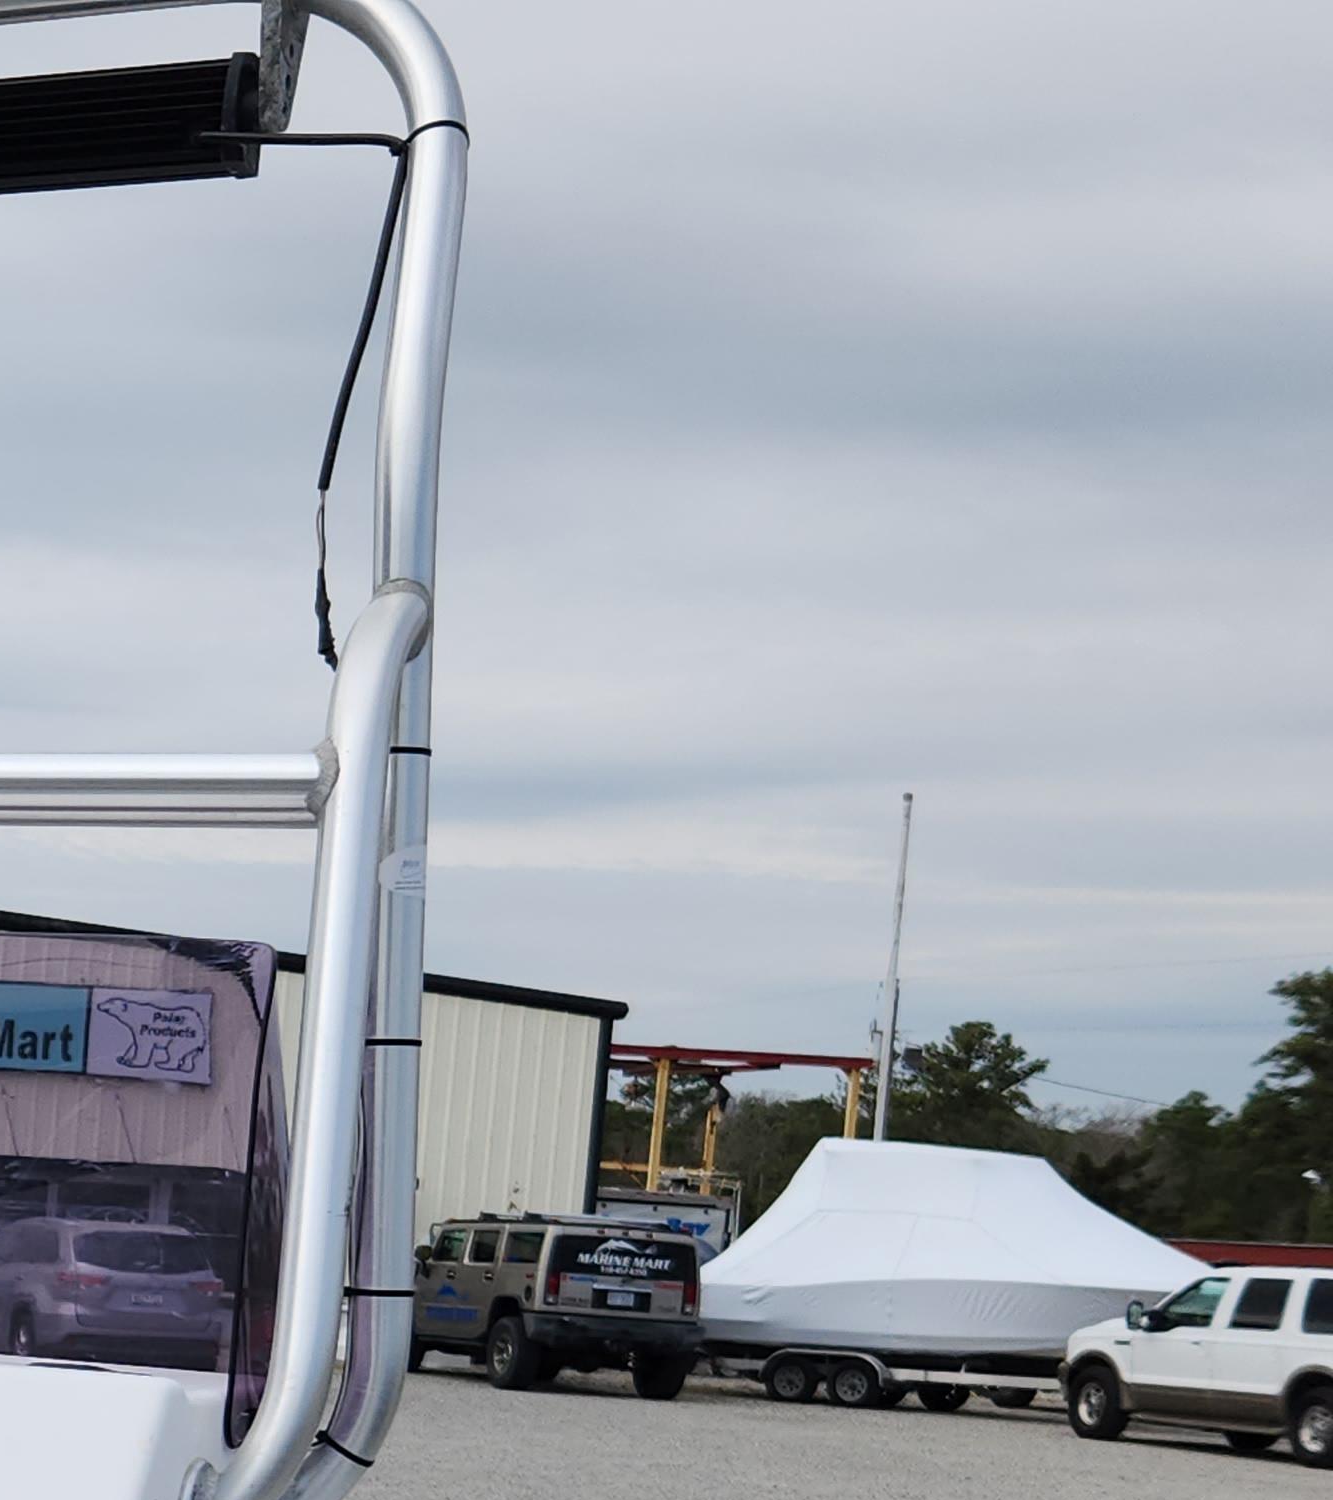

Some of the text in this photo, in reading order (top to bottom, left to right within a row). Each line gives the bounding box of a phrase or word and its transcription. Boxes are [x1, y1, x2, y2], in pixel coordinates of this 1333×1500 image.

[139, 1024, 197, 1038] Products
[577, 1253, 672, 1270] MARINE MART
